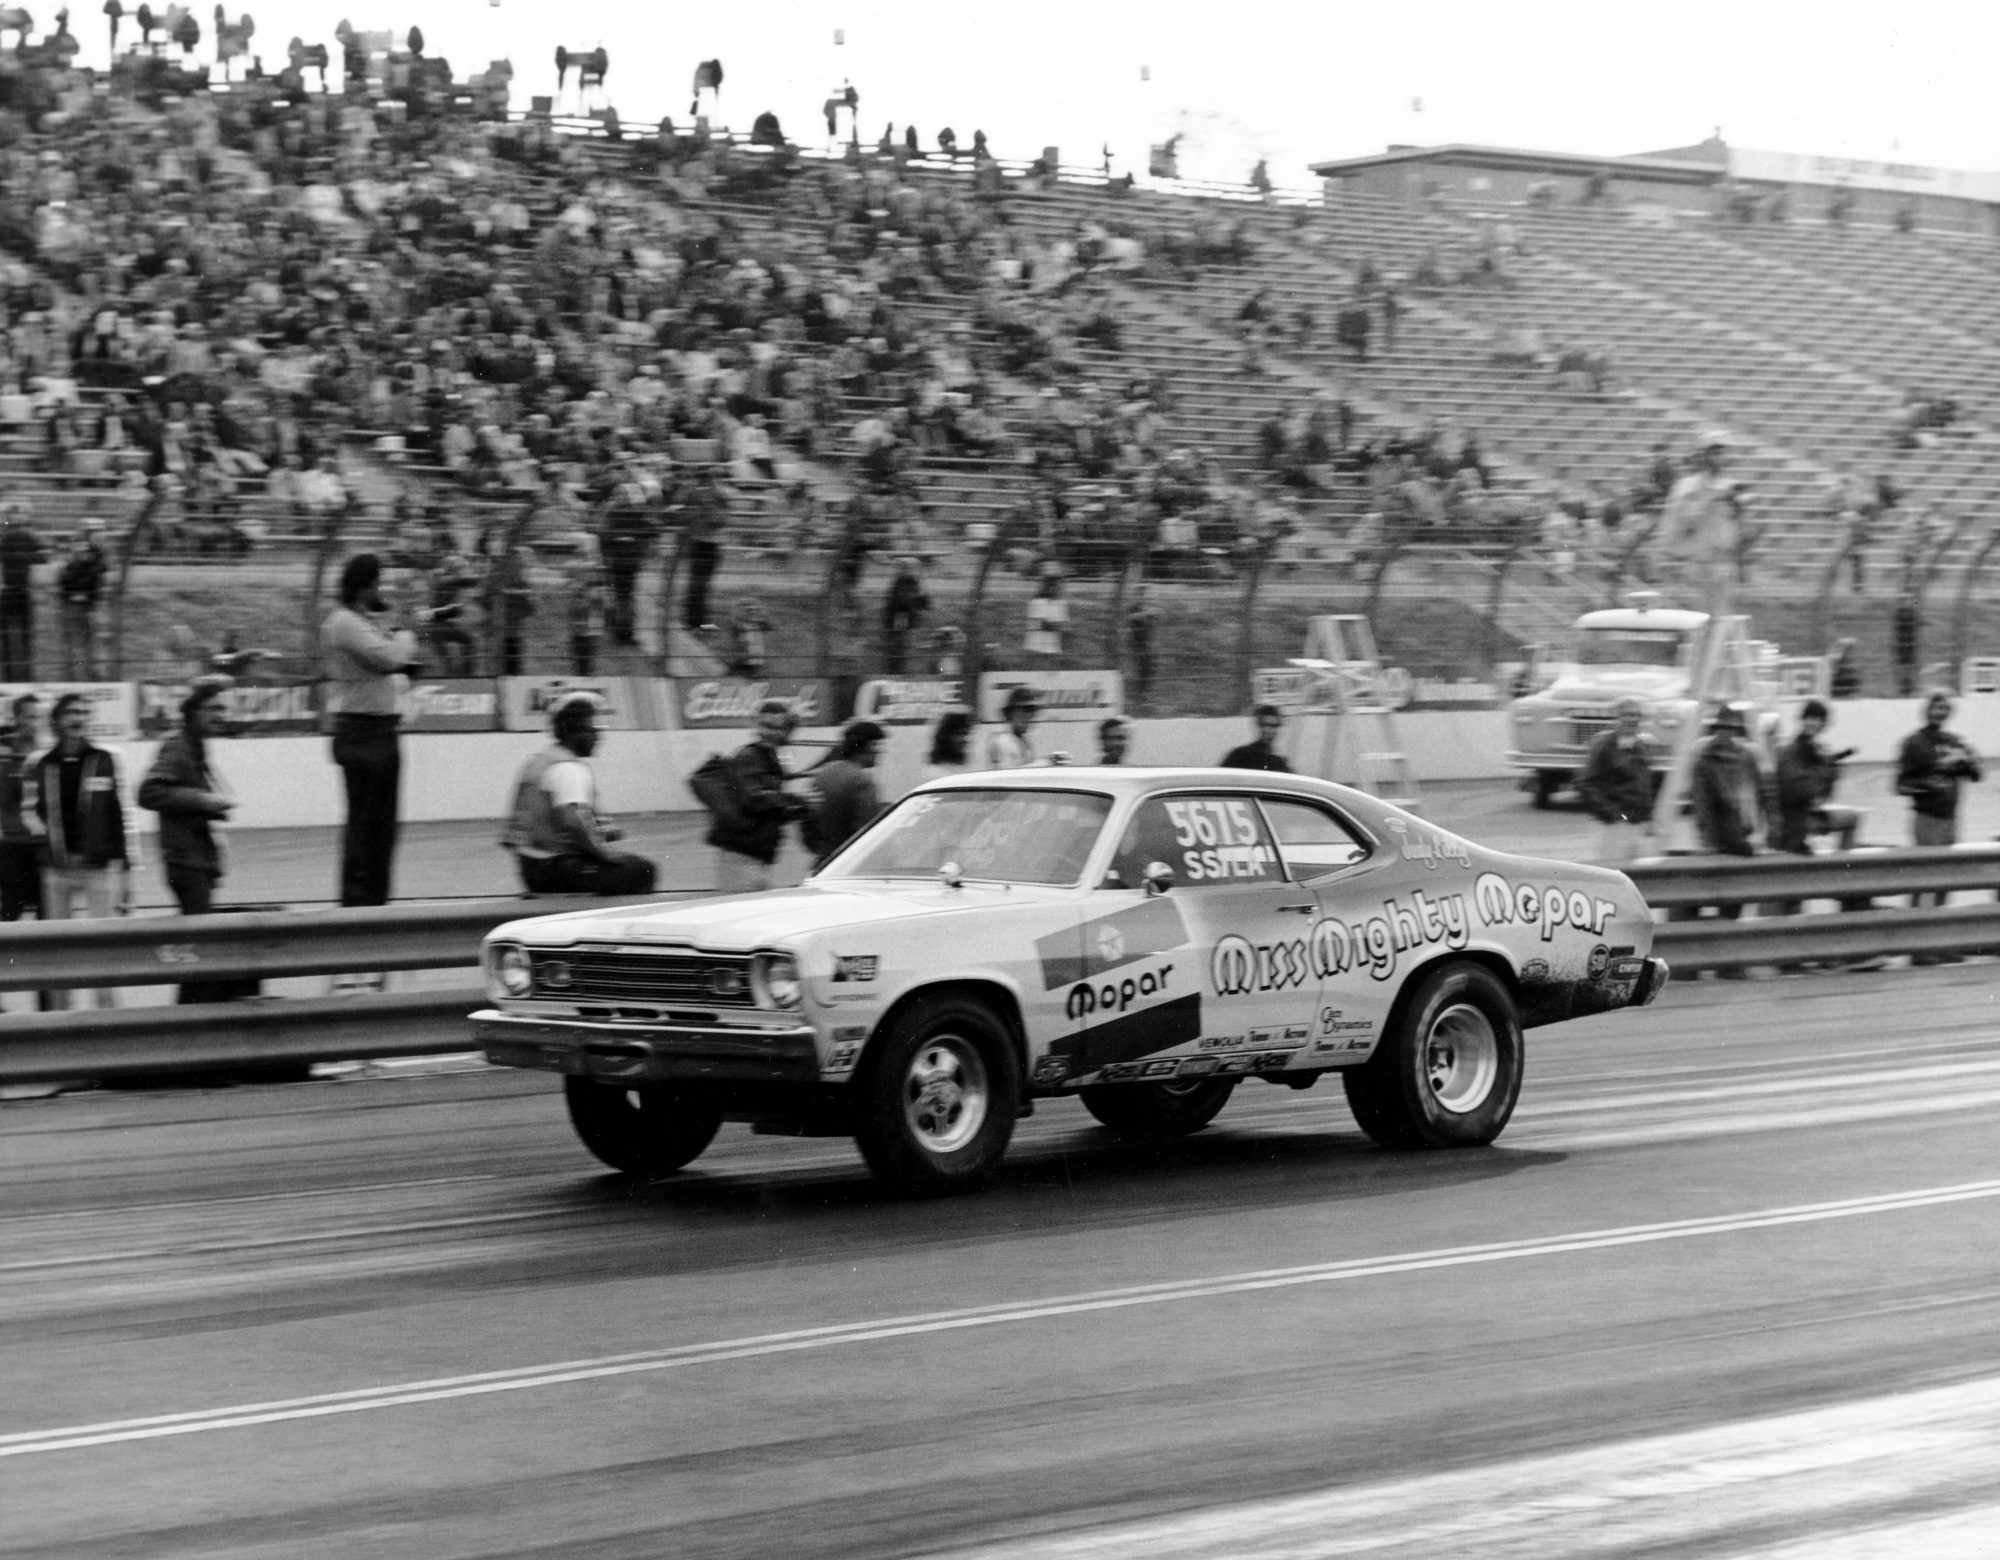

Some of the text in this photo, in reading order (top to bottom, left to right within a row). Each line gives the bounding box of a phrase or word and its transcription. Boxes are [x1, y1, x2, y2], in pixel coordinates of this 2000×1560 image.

[1163, 801, 1258, 847] 5675
[1309, 889, 1470, 982] Mighty
[1474, 871, 1617, 942] Mopar
[1066, 964, 1174, 1021] Mopar
[1322, 1019, 1373, 1035] Dynamics
